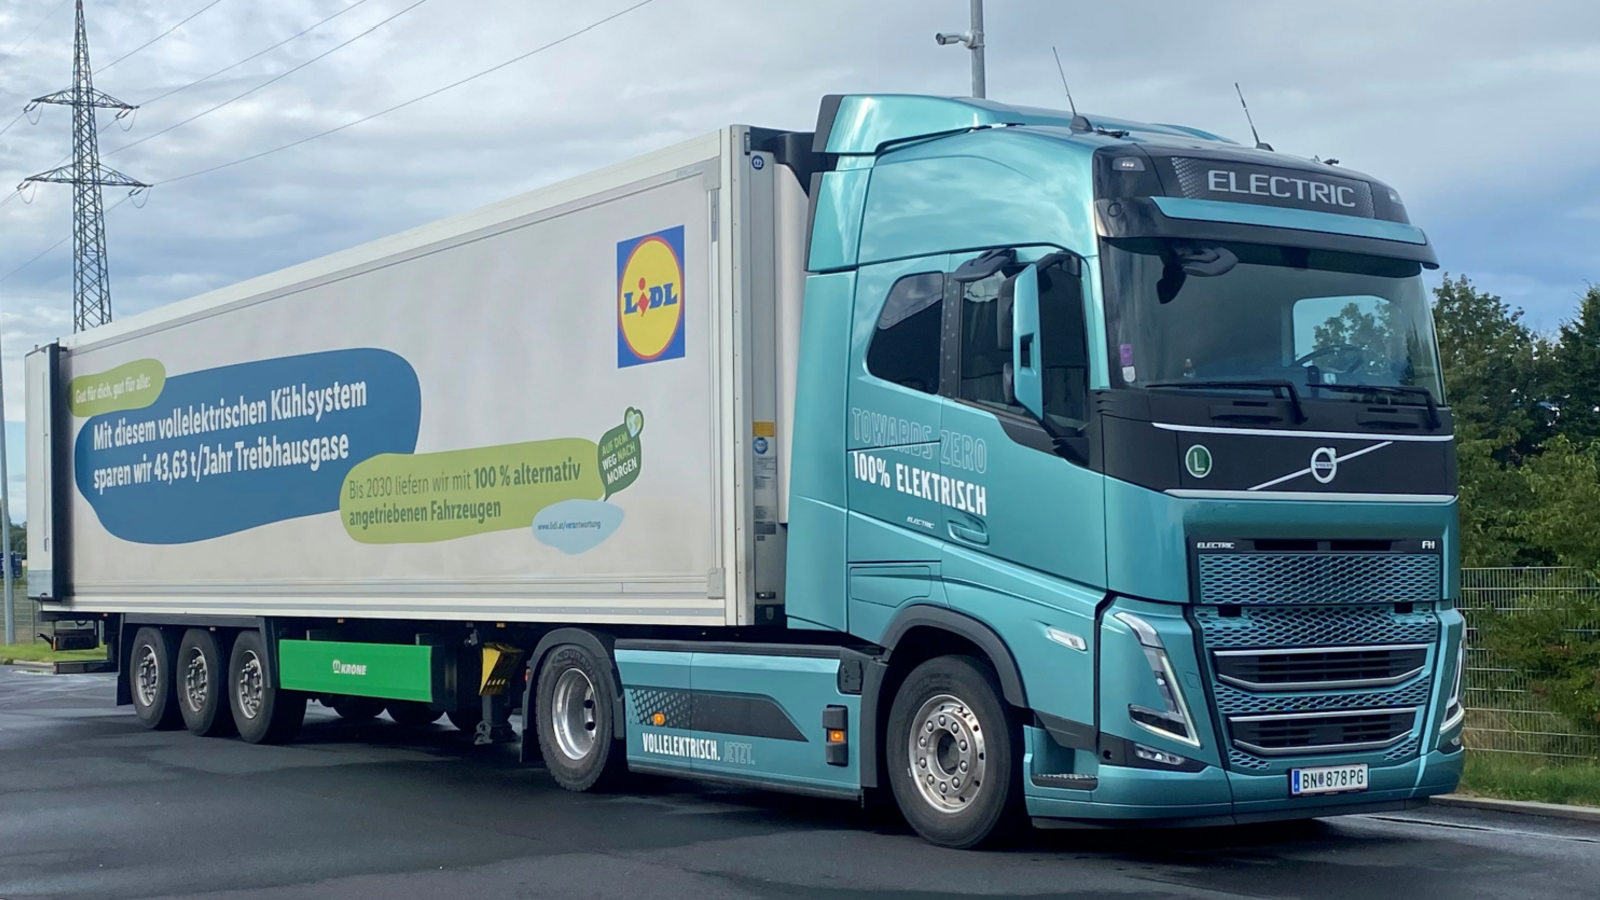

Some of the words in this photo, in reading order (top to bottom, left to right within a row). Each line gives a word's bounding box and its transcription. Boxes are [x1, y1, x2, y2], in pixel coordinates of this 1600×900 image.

[1207, 169, 1356, 208] ELECTRIC
[75, 389, 87, 404] Gut
[87, 385, 96, 401] für
[97, 382, 113, 399] dich,
[113, 380, 124, 400] gut
[125, 376, 135, 393] für
[94, 420, 113, 451] Mit
[114, 417, 156, 447] diesem
[158, 395, 267, 440] vollelektrischen
[270, 380, 367, 423] Kühlsystem
[601, 440, 614, 457] AUF
[613, 431, 629, 449] DEM
[852, 407, 933, 460] TOWARDS
[940, 429, 987, 474] ZERO
[93, 464, 131, 495] sparen
[133, 453, 152, 484] wir
[153, 449, 188, 485] 43,63
[190, 443, 233, 483] t/Jahr
[234, 433, 349, 472] Treibhausgase
[601, 453, 617, 471] WEG
[617, 441, 636, 462] NACH
[606, 456, 638, 486] MORGEN
[1193, 451, 1206, 472] L
[349, 480, 364, 499] Bis
[366, 476, 392, 498] 2030
[395, 473, 429, 496] liefern
[432, 471, 450, 492] wir
[452, 469, 471, 490] mit
[474, 465, 497, 489] 100
[499, 464, 511, 487] %
[513, 456, 581, 486] alternativ
[853, 450, 891, 489] 100%
[895, 462, 987, 517] ELEKTRISCH
[349, 502, 428, 531] angetriebenen
[430, 499, 501, 525] Fahrzeugen
[906, 516, 935, 530] ELECTRIC
[1196, 541, 1235, 549] ELECTRIC
[1421, 540, 1435, 549] FH
[340, 663, 366, 675] KRONE
[642, 732, 721, 762] VOLLELEKTRISCH.
[722, 740, 756, 765] JETZT.
[1302, 772, 1317, 789] BN
